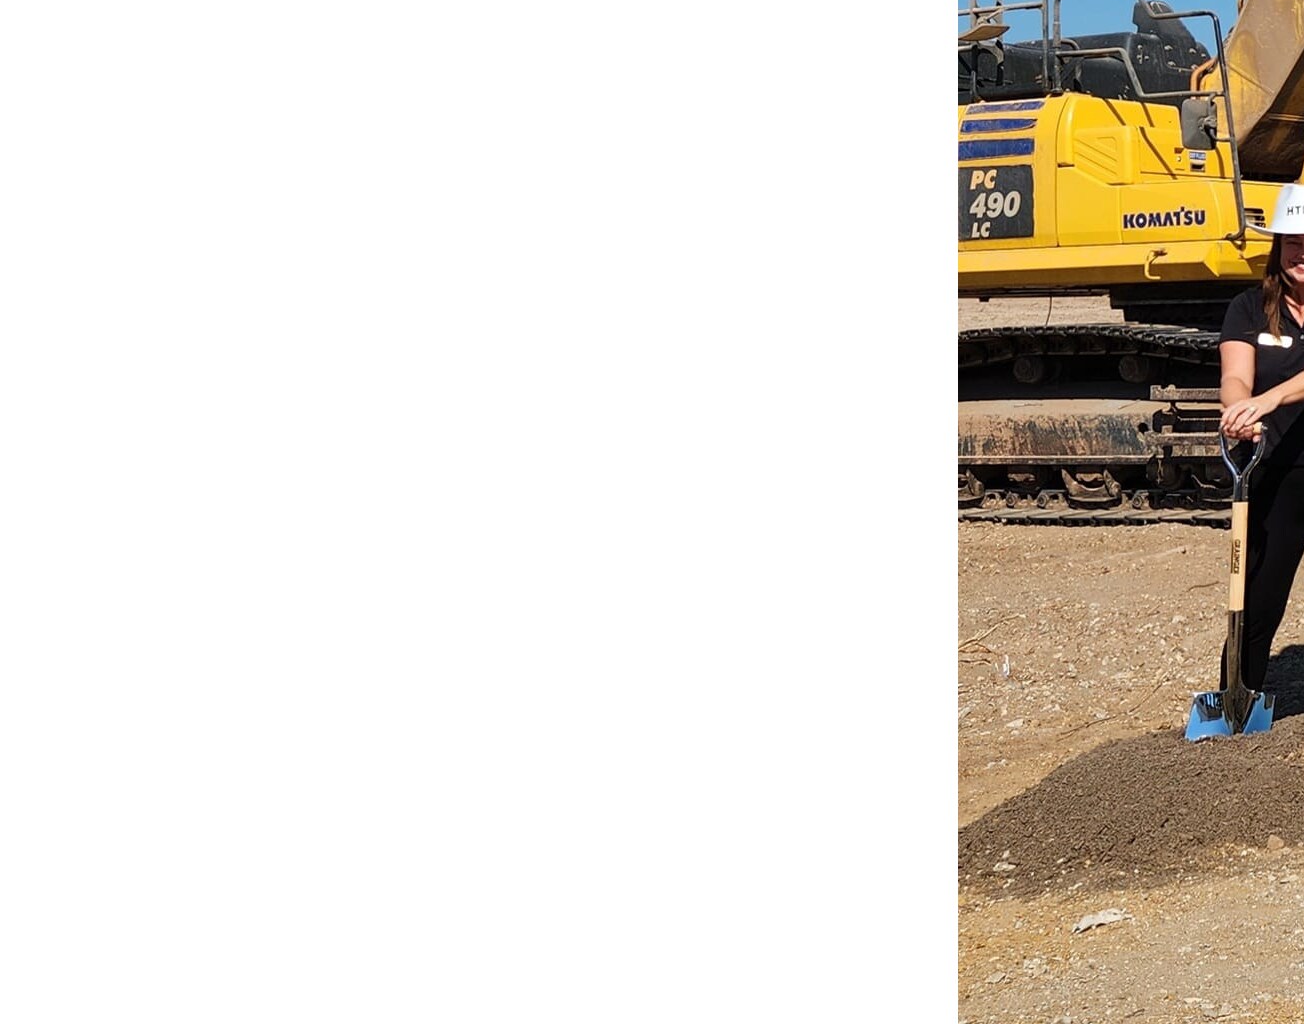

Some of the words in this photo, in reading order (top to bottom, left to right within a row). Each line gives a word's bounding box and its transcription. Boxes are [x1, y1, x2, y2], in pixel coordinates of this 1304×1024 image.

[969, 169, 998, 190] PC
[969, 190, 1021, 218] 490
[1123, 206, 1206, 229] KOMATSU
[971, 221, 991, 238] LC
